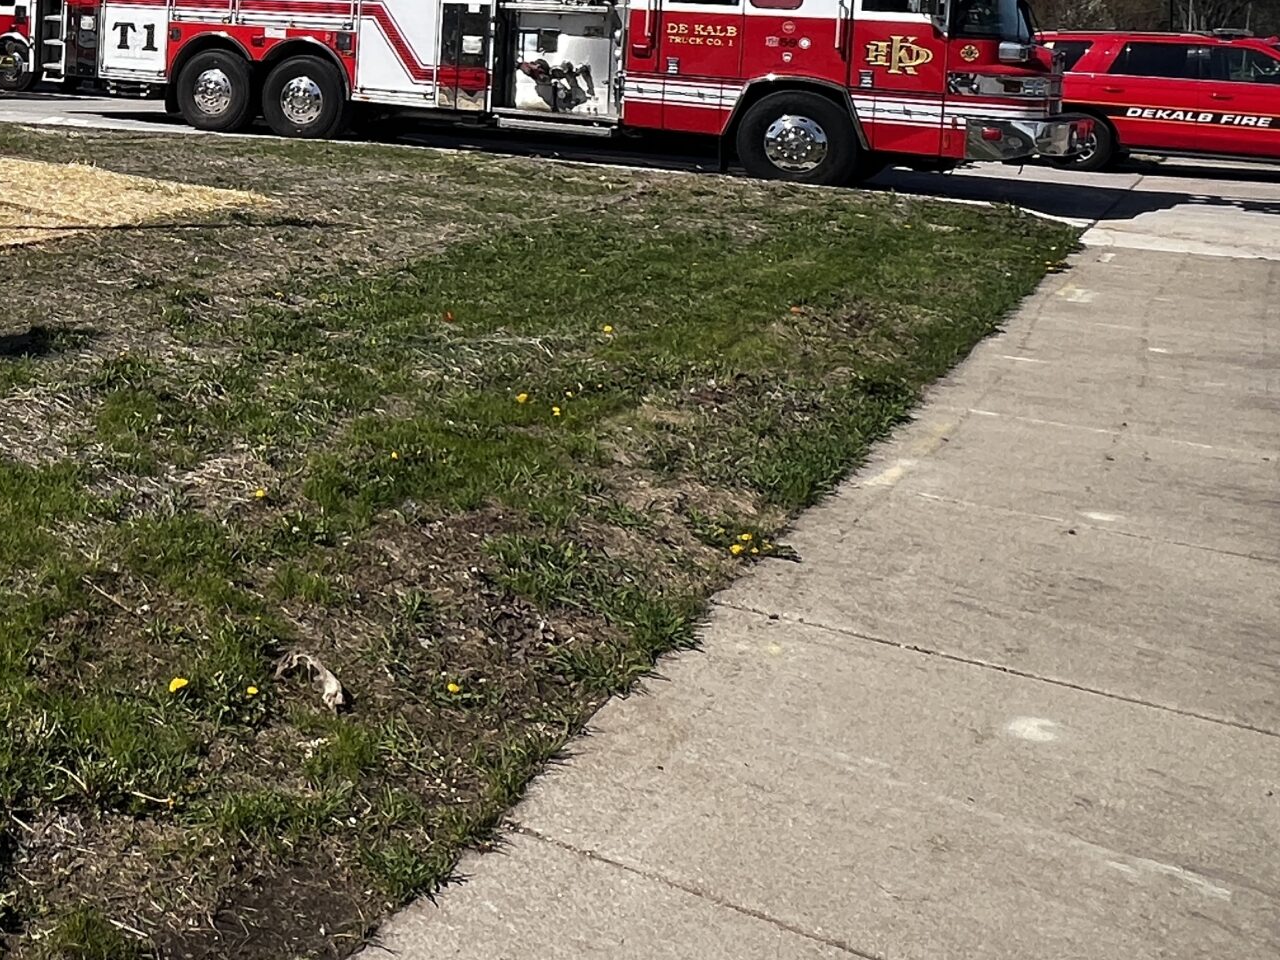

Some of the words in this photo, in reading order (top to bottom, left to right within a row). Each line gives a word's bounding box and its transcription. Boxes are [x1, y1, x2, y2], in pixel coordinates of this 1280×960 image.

[112, 22, 158, 52] T1
[667, 23, 688, 34] DE
[694, 24, 737, 36] KALB
[668, 36, 703, 45] TRUCK
[706, 38, 724, 46] CO.
[1126, 107, 1214, 122] DEKALB
[1220, 115, 1273, 127] FIRE
